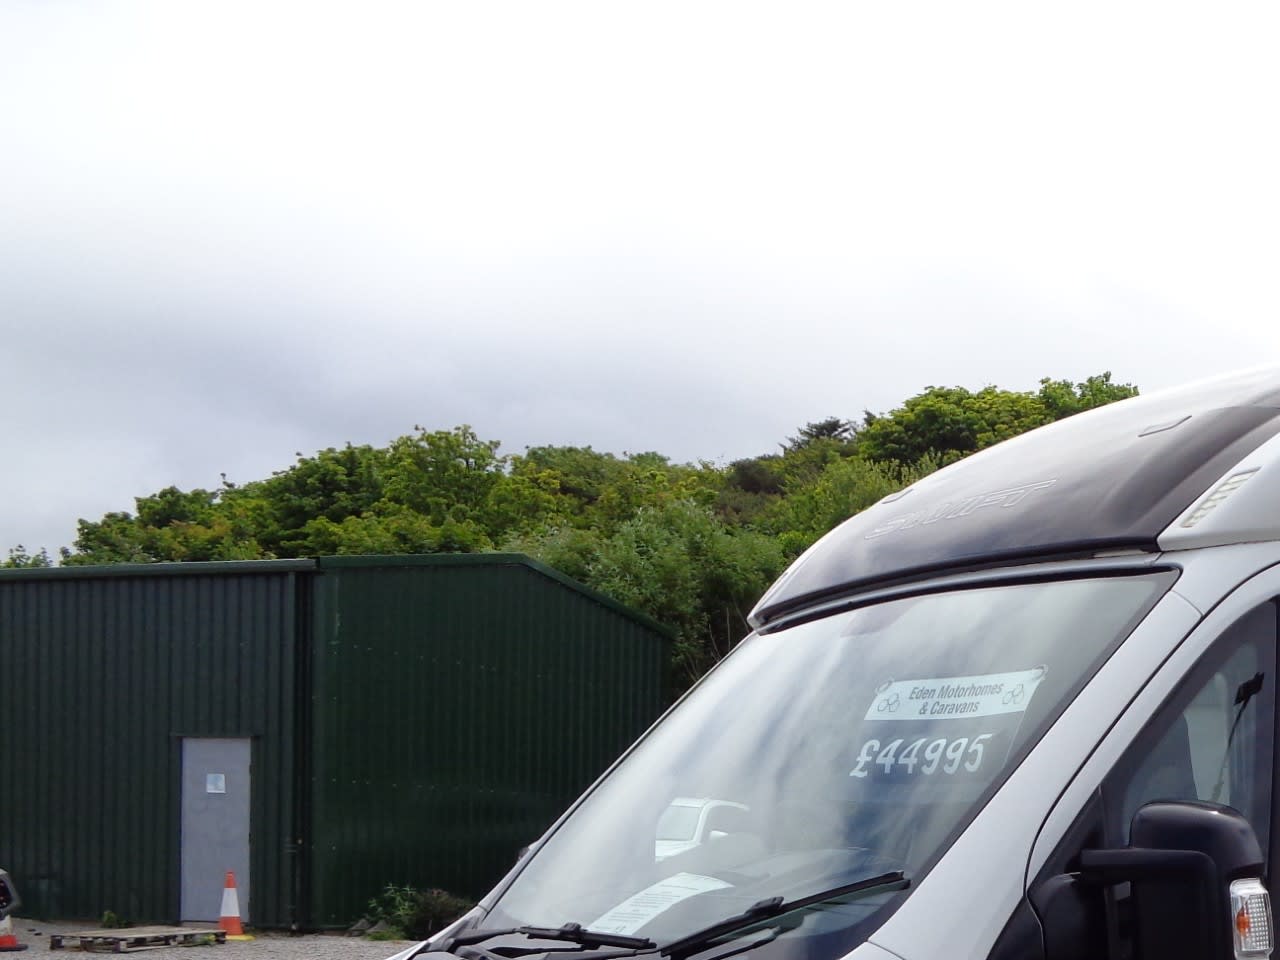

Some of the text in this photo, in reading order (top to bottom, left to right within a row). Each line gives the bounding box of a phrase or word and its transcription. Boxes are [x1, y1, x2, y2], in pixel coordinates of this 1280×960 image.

[909, 683, 1004, 700] Eden Motorhomes
[919, 701, 980, 715] & Caravans
[849, 733, 993, 778] £44995
